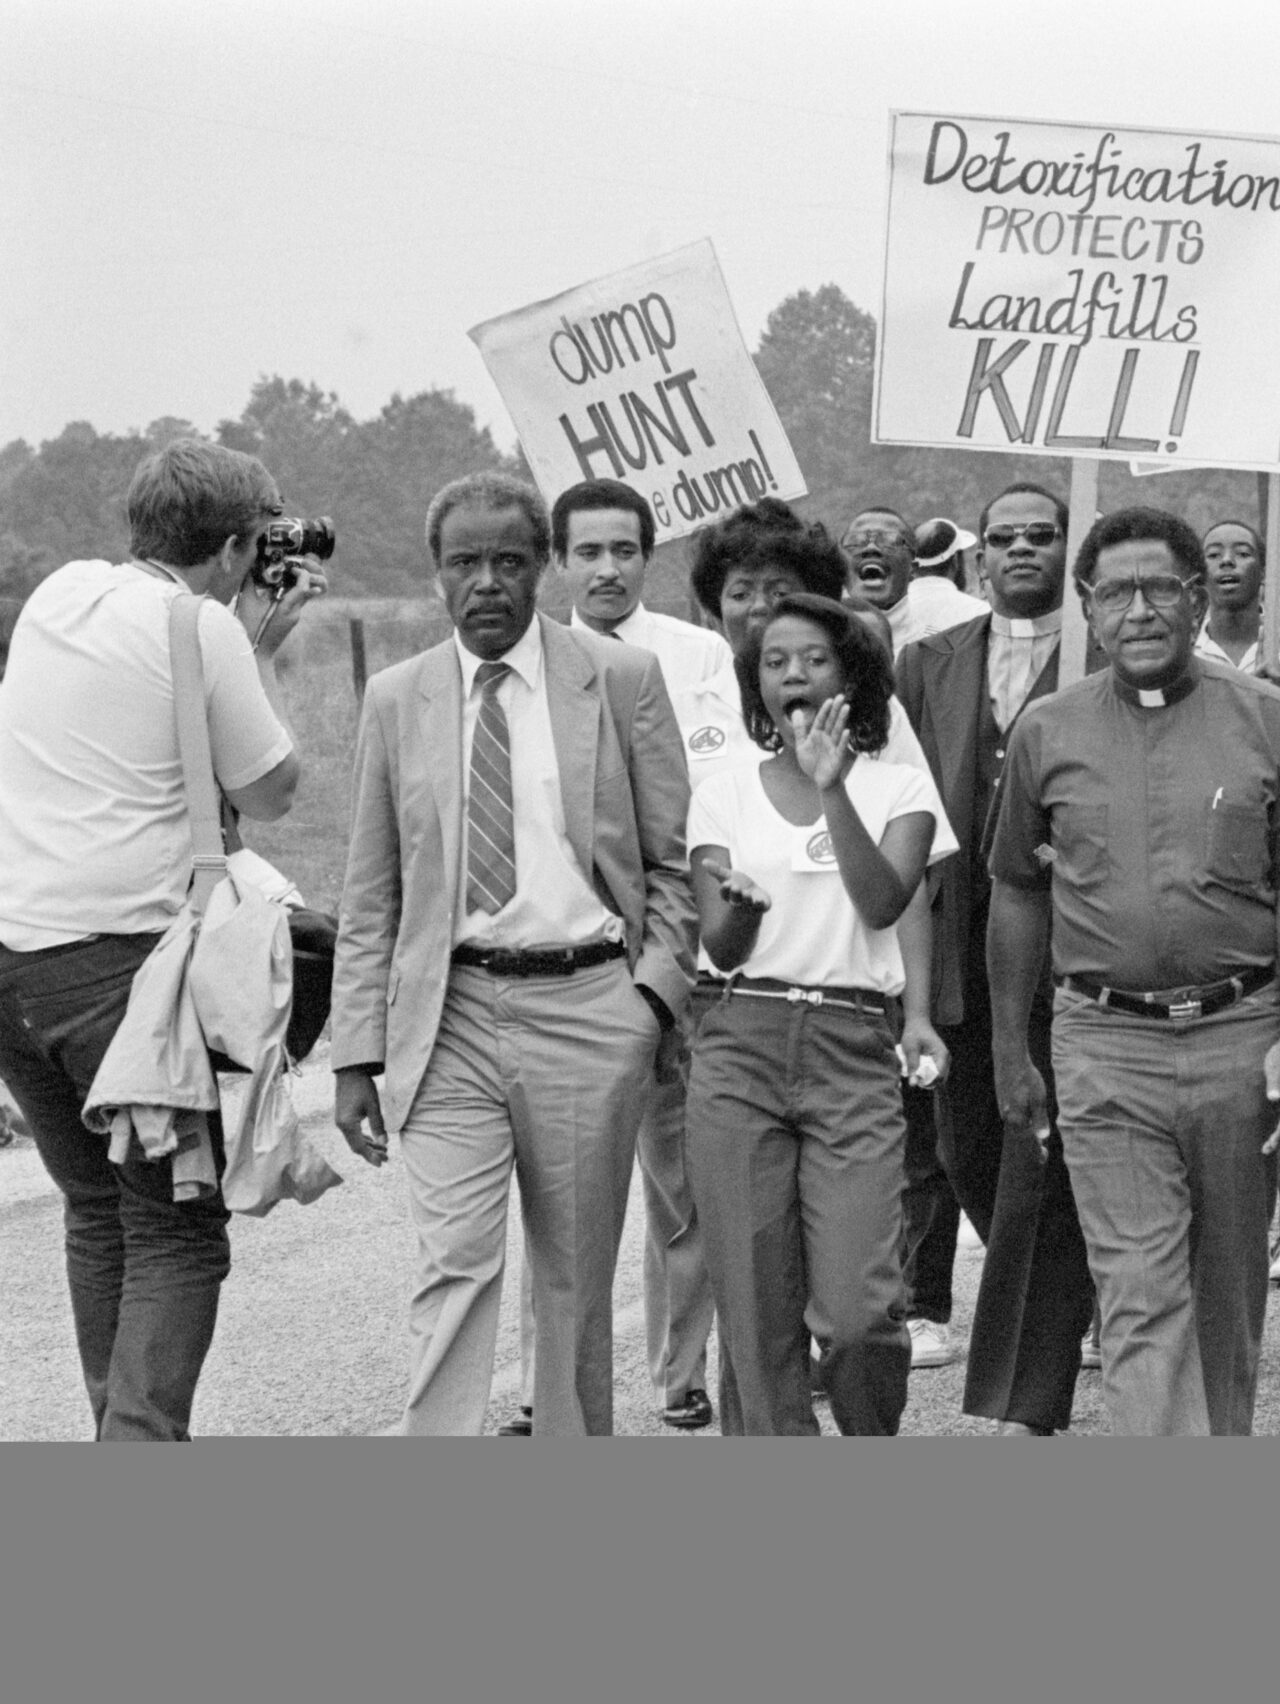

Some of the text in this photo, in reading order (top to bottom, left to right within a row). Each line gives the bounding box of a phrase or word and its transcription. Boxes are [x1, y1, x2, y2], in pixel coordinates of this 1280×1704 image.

[975, 205, 1205, 265] PROTECTS
[549, 292, 677, 385] dump
[948, 261, 1198, 347] Landfills
[558, 367, 717, 483] HUNT
[956, 337, 1201, 453] KILL!
[672, 429, 779, 523] dump!
